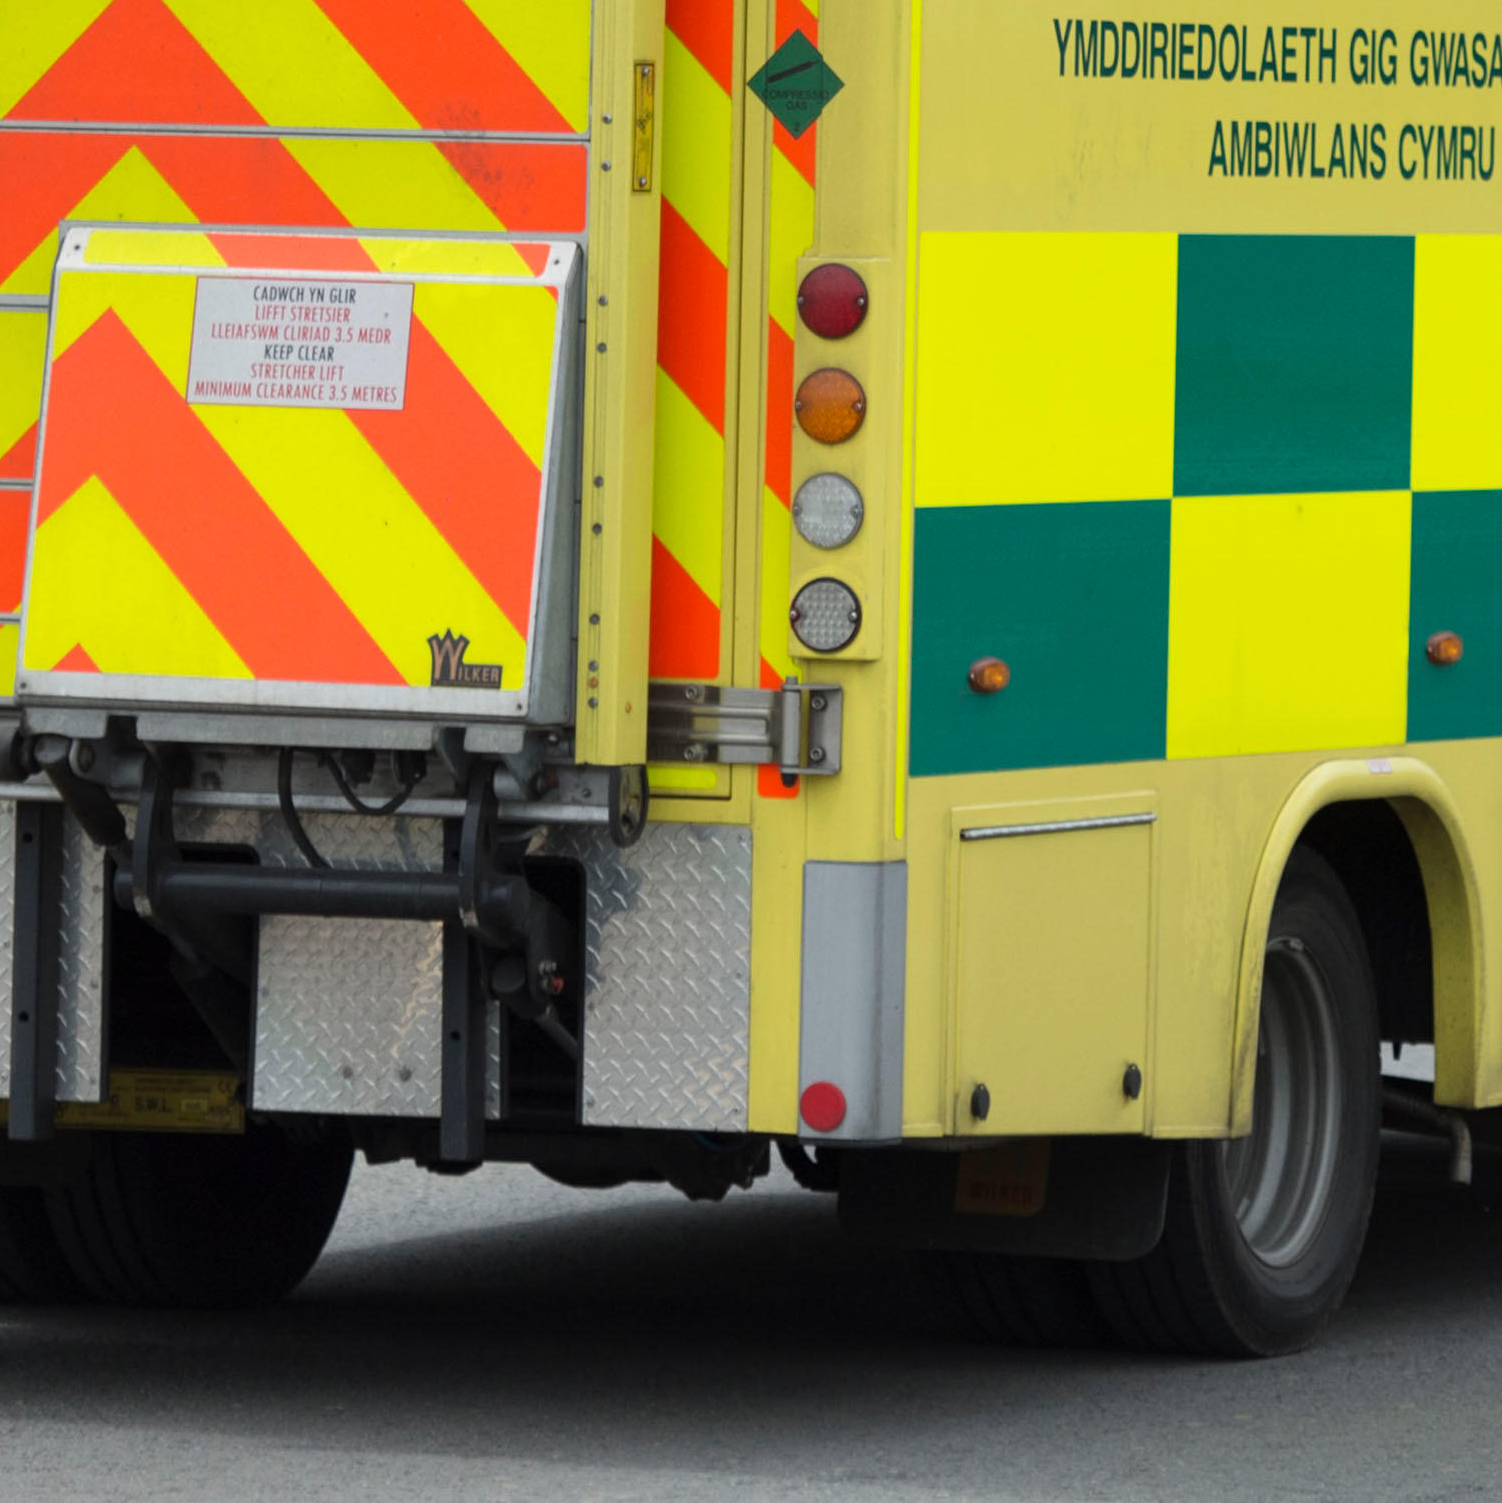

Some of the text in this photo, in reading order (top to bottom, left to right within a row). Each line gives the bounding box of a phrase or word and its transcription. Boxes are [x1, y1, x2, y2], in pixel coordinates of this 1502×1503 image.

[1053, 18, 1337, 84] YMDDIRIEDOLAETH
[1349, 28, 1397, 86] GIG
[1207, 120, 1496, 181] AMBIWLANS CYMRU
[253, 285, 356, 304] CADWCH YN GLIR
[255, 305, 351, 323] LIFFT STRETSIER
[211, 323, 392, 344] LLEIAFSWM CLIRIAD 3.5 MEDR
[264, 345, 334, 362] KEEP CLEAR
[250, 363, 345, 381] STRETCHER LIFT
[194, 381, 397, 403] MINIMUM CLEARANCE 3.5 METRES
[428, 629, 500, 684] WILKER
